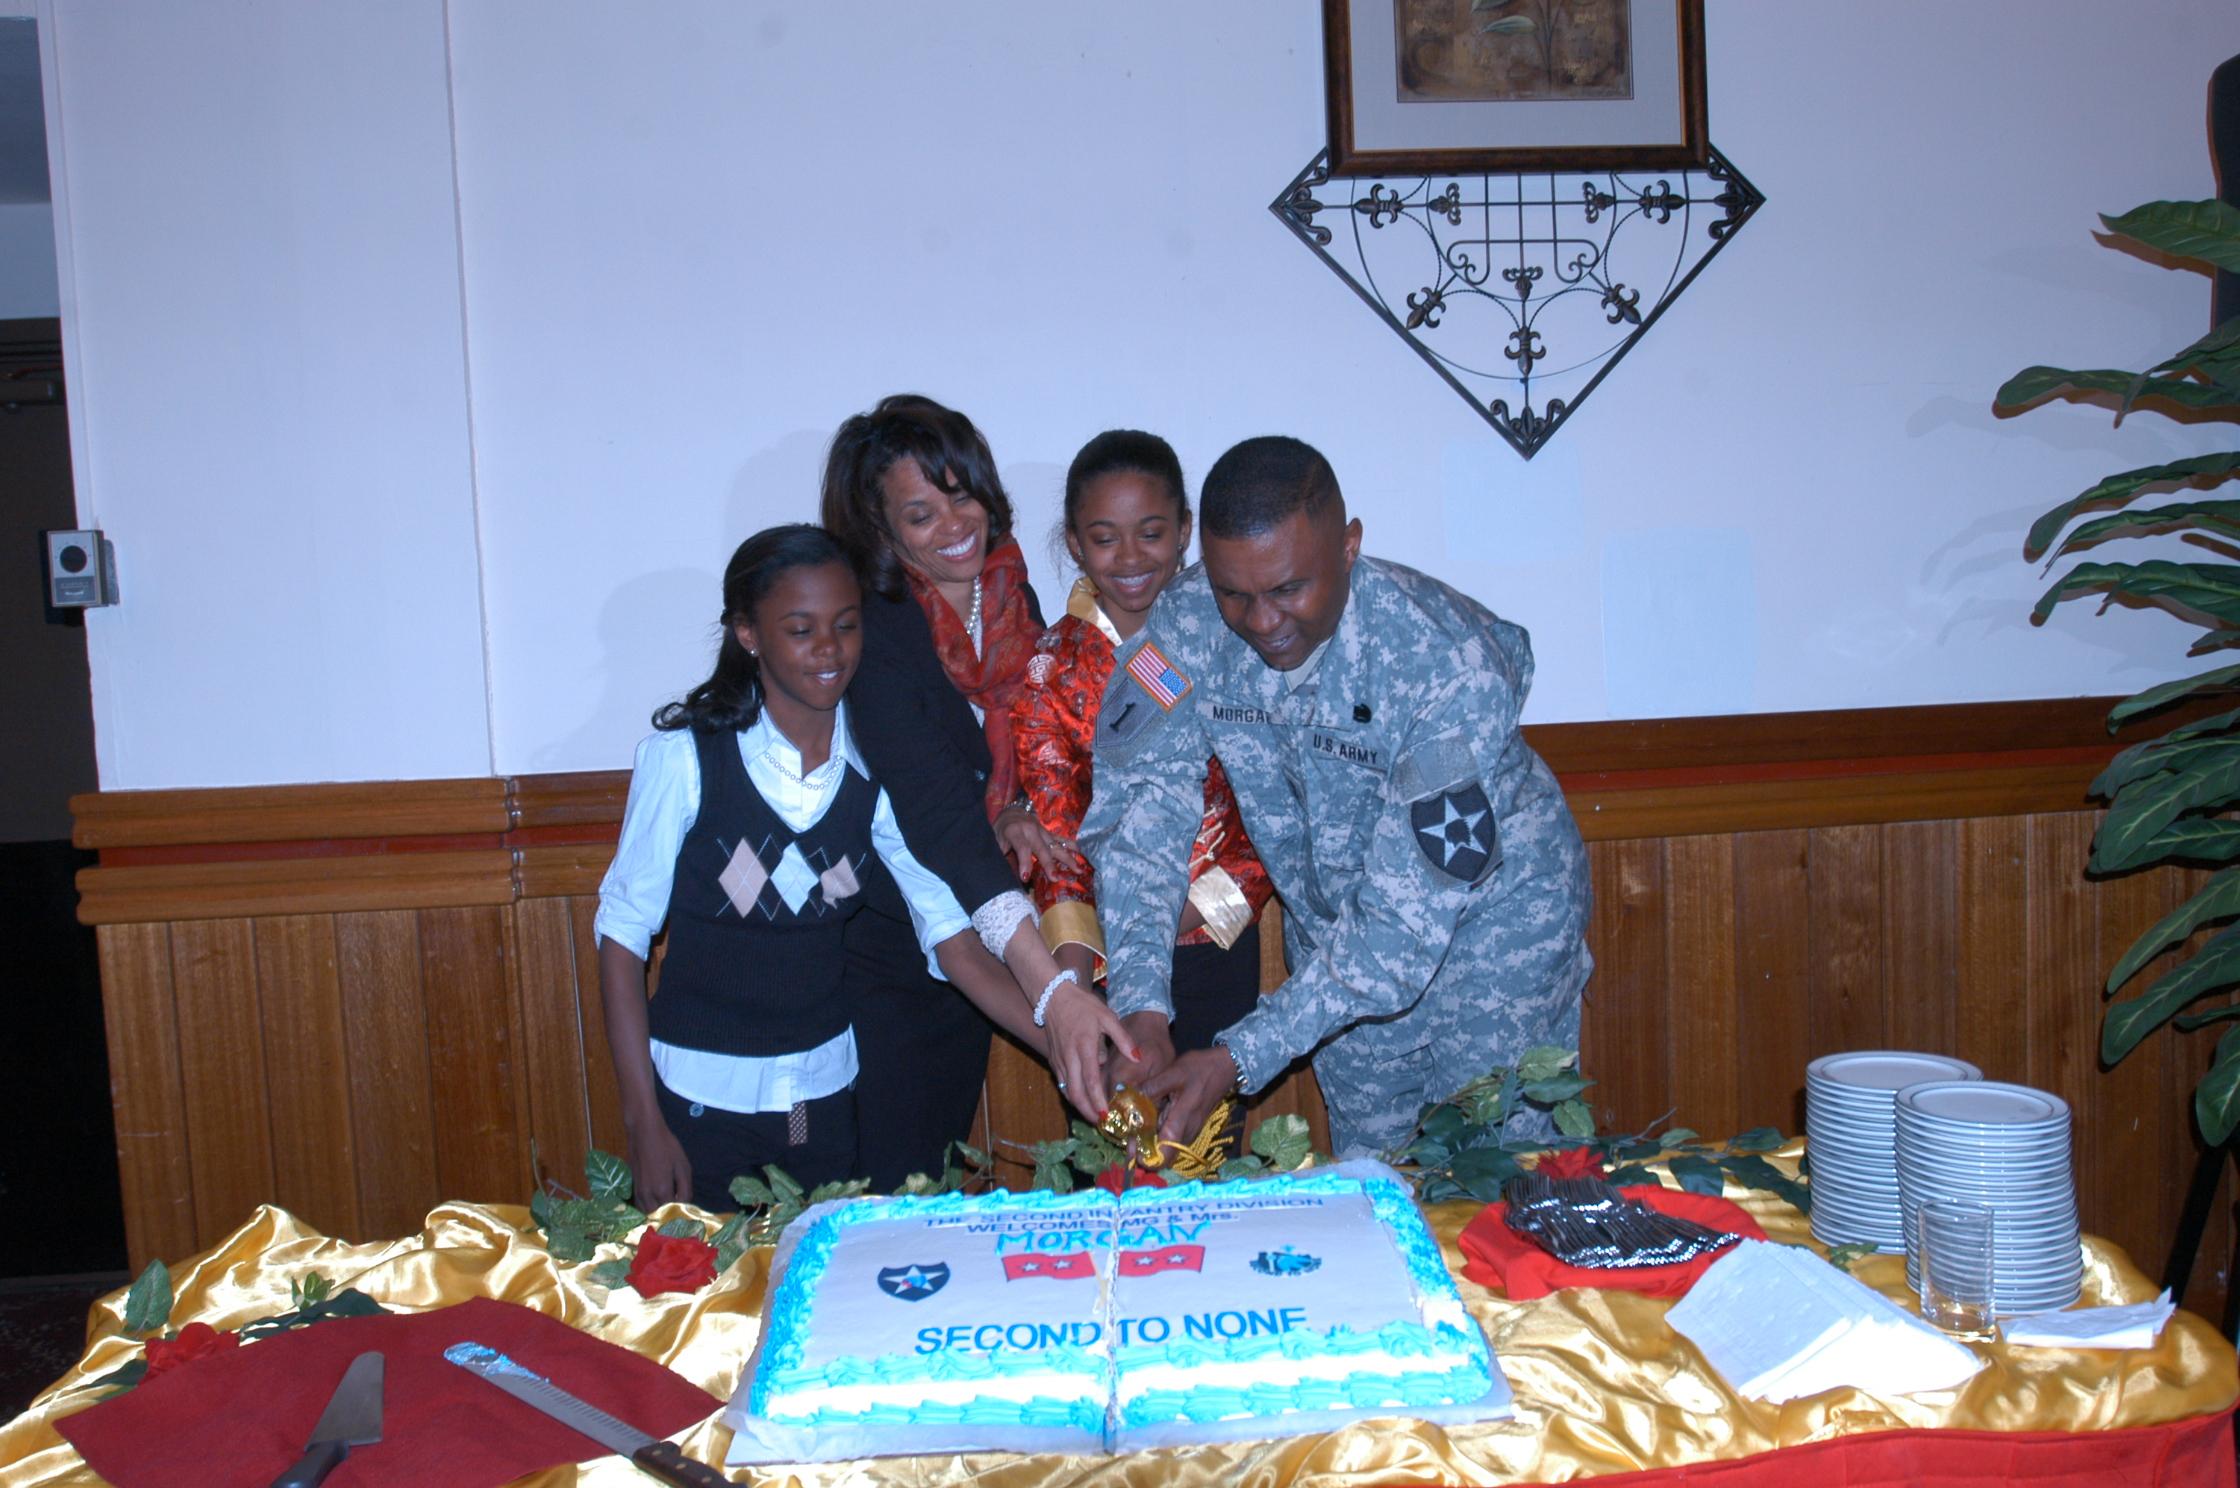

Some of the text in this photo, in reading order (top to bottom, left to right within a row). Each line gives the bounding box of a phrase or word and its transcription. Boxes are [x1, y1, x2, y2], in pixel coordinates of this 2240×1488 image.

[1339, 743, 1378, 764] ARMY
[925, 1217, 962, 1227] THE
[980, 1210, 1083, 1223] SECOND
[1216, 1197, 1323, 1210] DIVISION
[967, 1210, 1239, 1233] WELCOMES MG & Mrs.
[995, 1218, 1212, 1256] MORGAN
[915, 1306, 1306, 1355] SECOND TO NONE
